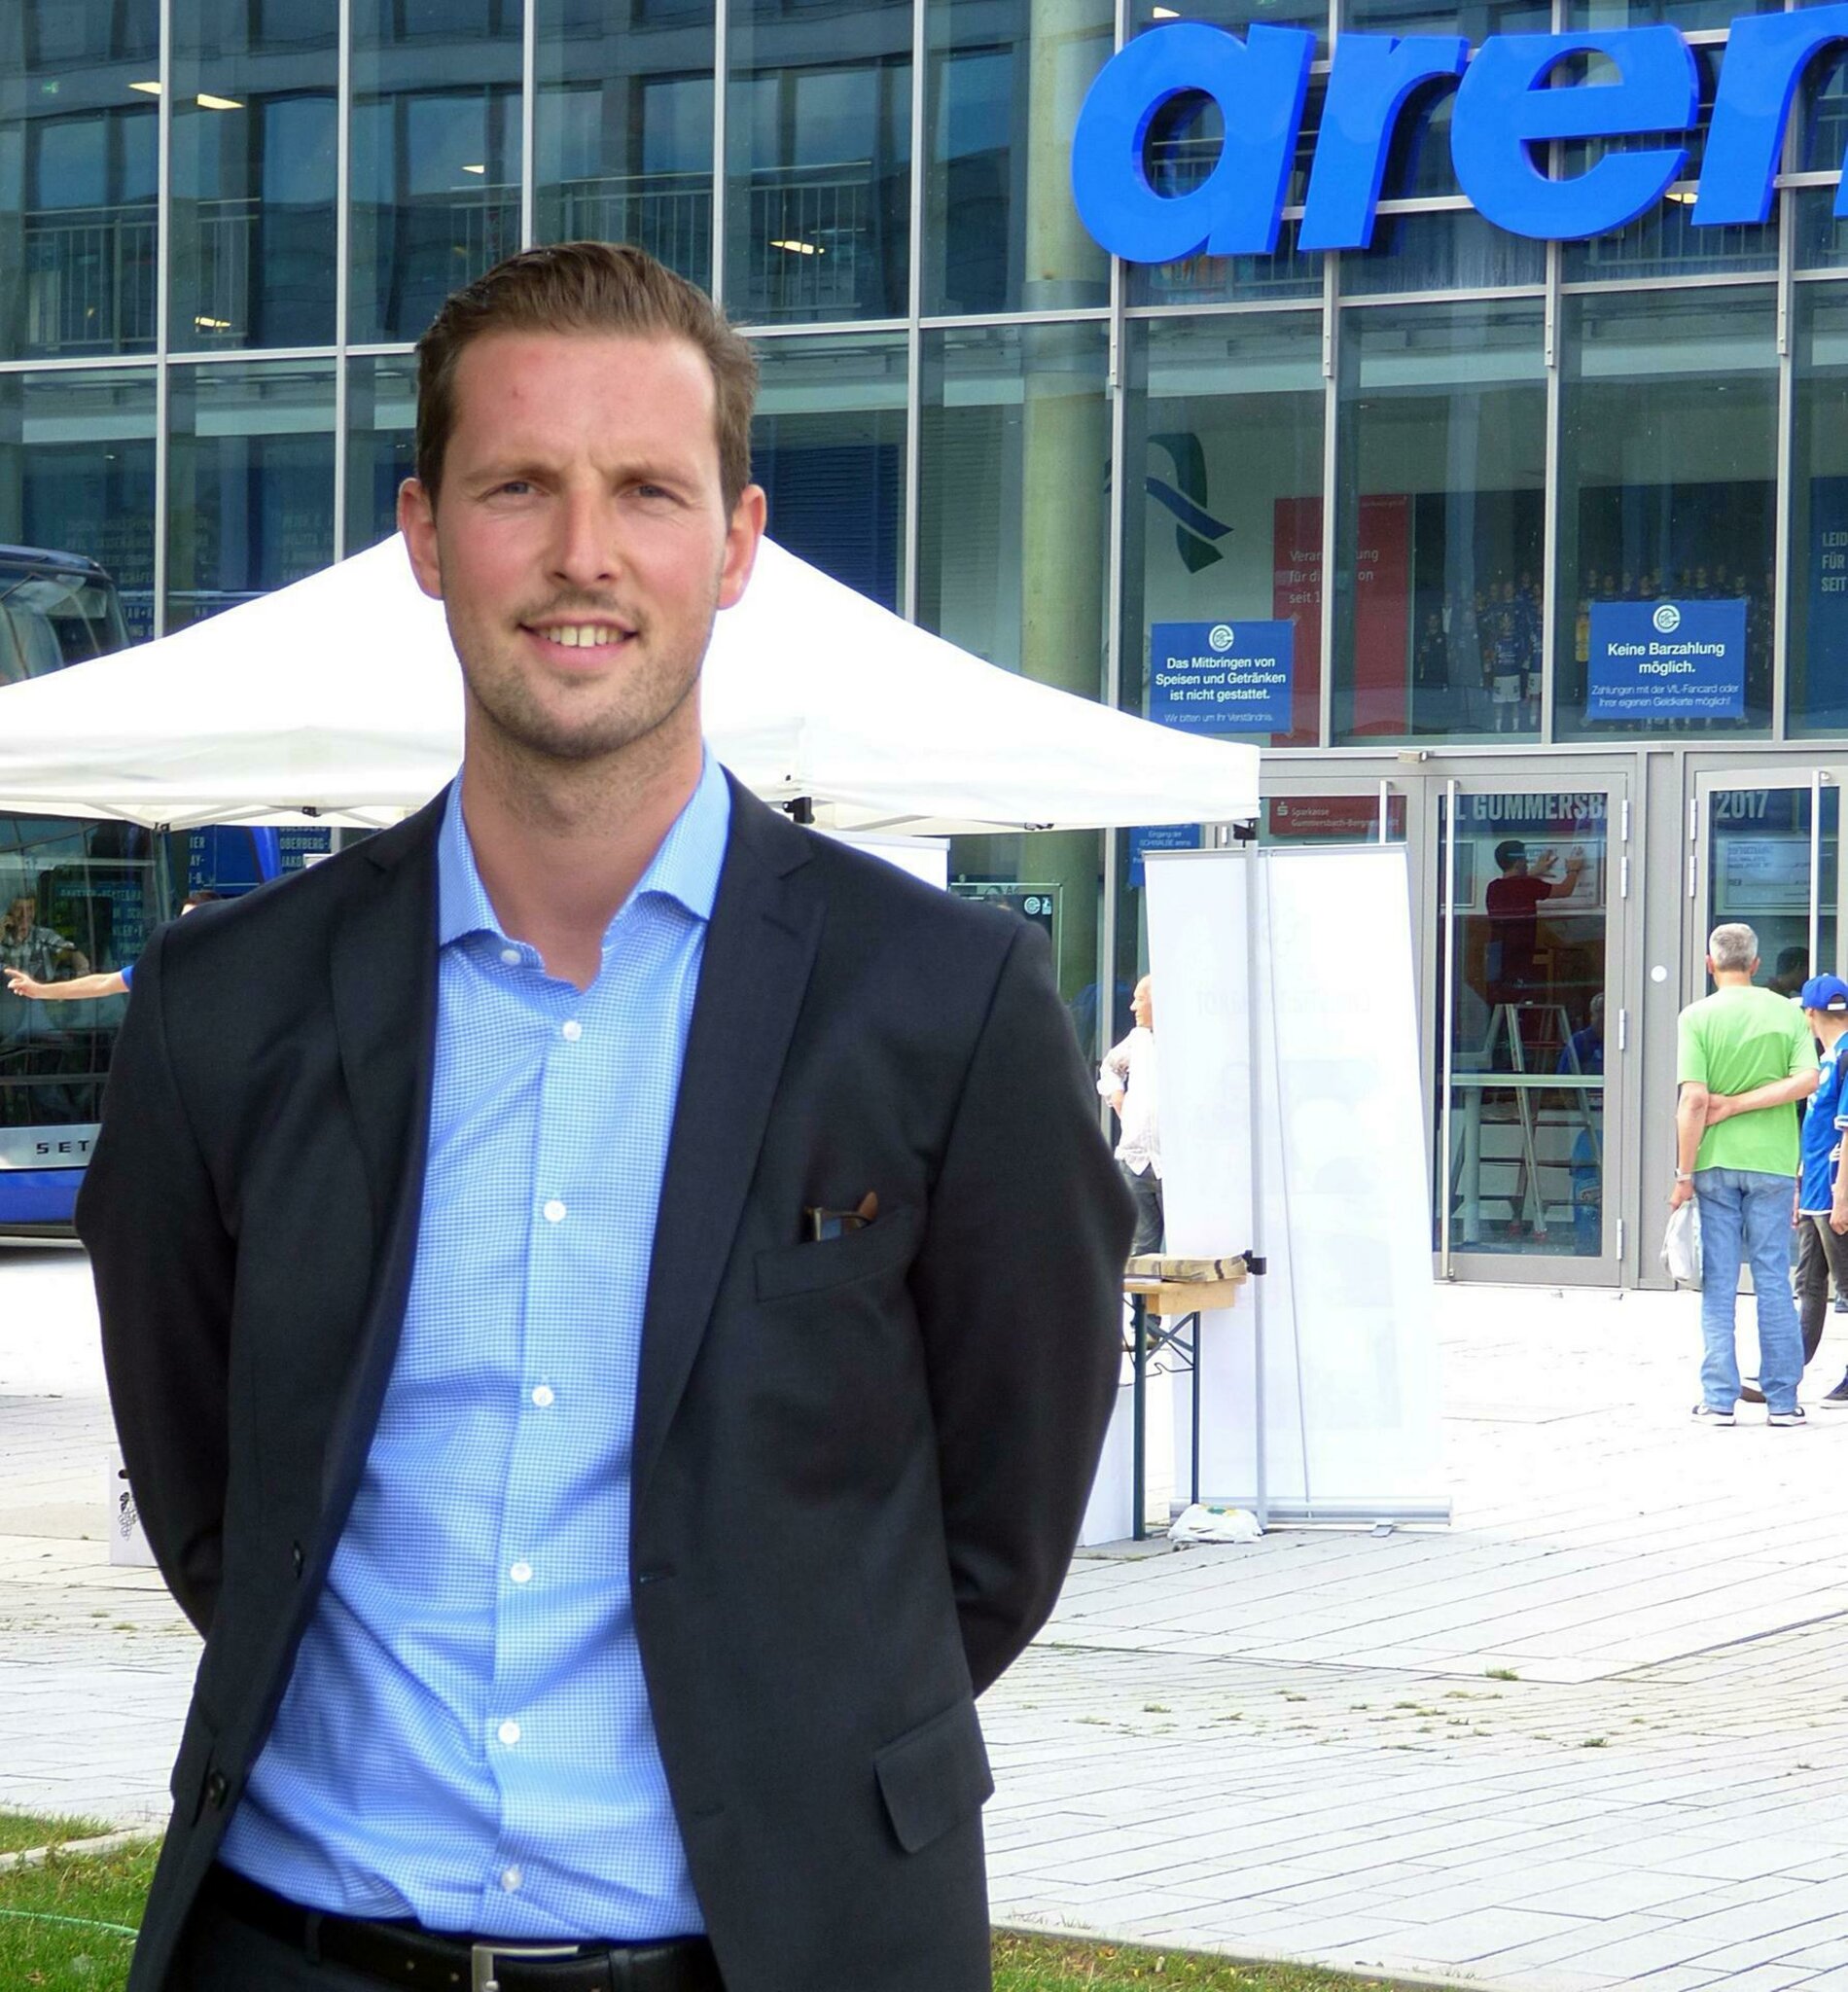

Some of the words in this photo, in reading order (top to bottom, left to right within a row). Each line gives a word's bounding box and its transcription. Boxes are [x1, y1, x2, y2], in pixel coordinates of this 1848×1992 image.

[1072, 4, 1848, 264] aren
[1822, 551, 1845, 569] FÜR
[1821, 576, 1847, 591] SEIT
[1608, 643, 1646, 656] Keine
[1649, 642, 1724, 657] Barzahlung
[1166, 658, 1189, 669] Das
[1191, 657, 1252, 670] Mitbringen
[1255, 658, 1275, 667] von
[1639, 660, 1696, 676] möglich.
[1155, 673, 1200, 687] Speisen
[1203, 673, 1225, 684] und
[1227, 672, 1286, 684] Getränken
[1170, 690, 1184, 700] ist
[1187, 689, 1214, 700] nicht
[1217, 689, 1270, 702] gestattet.
[1637, 685, 1649, 694] mit
[1473, 793, 1607, 820] GUMMERSB
[1716, 790, 1769, 819] 2017
[36, 1139, 89, 1155] SET
